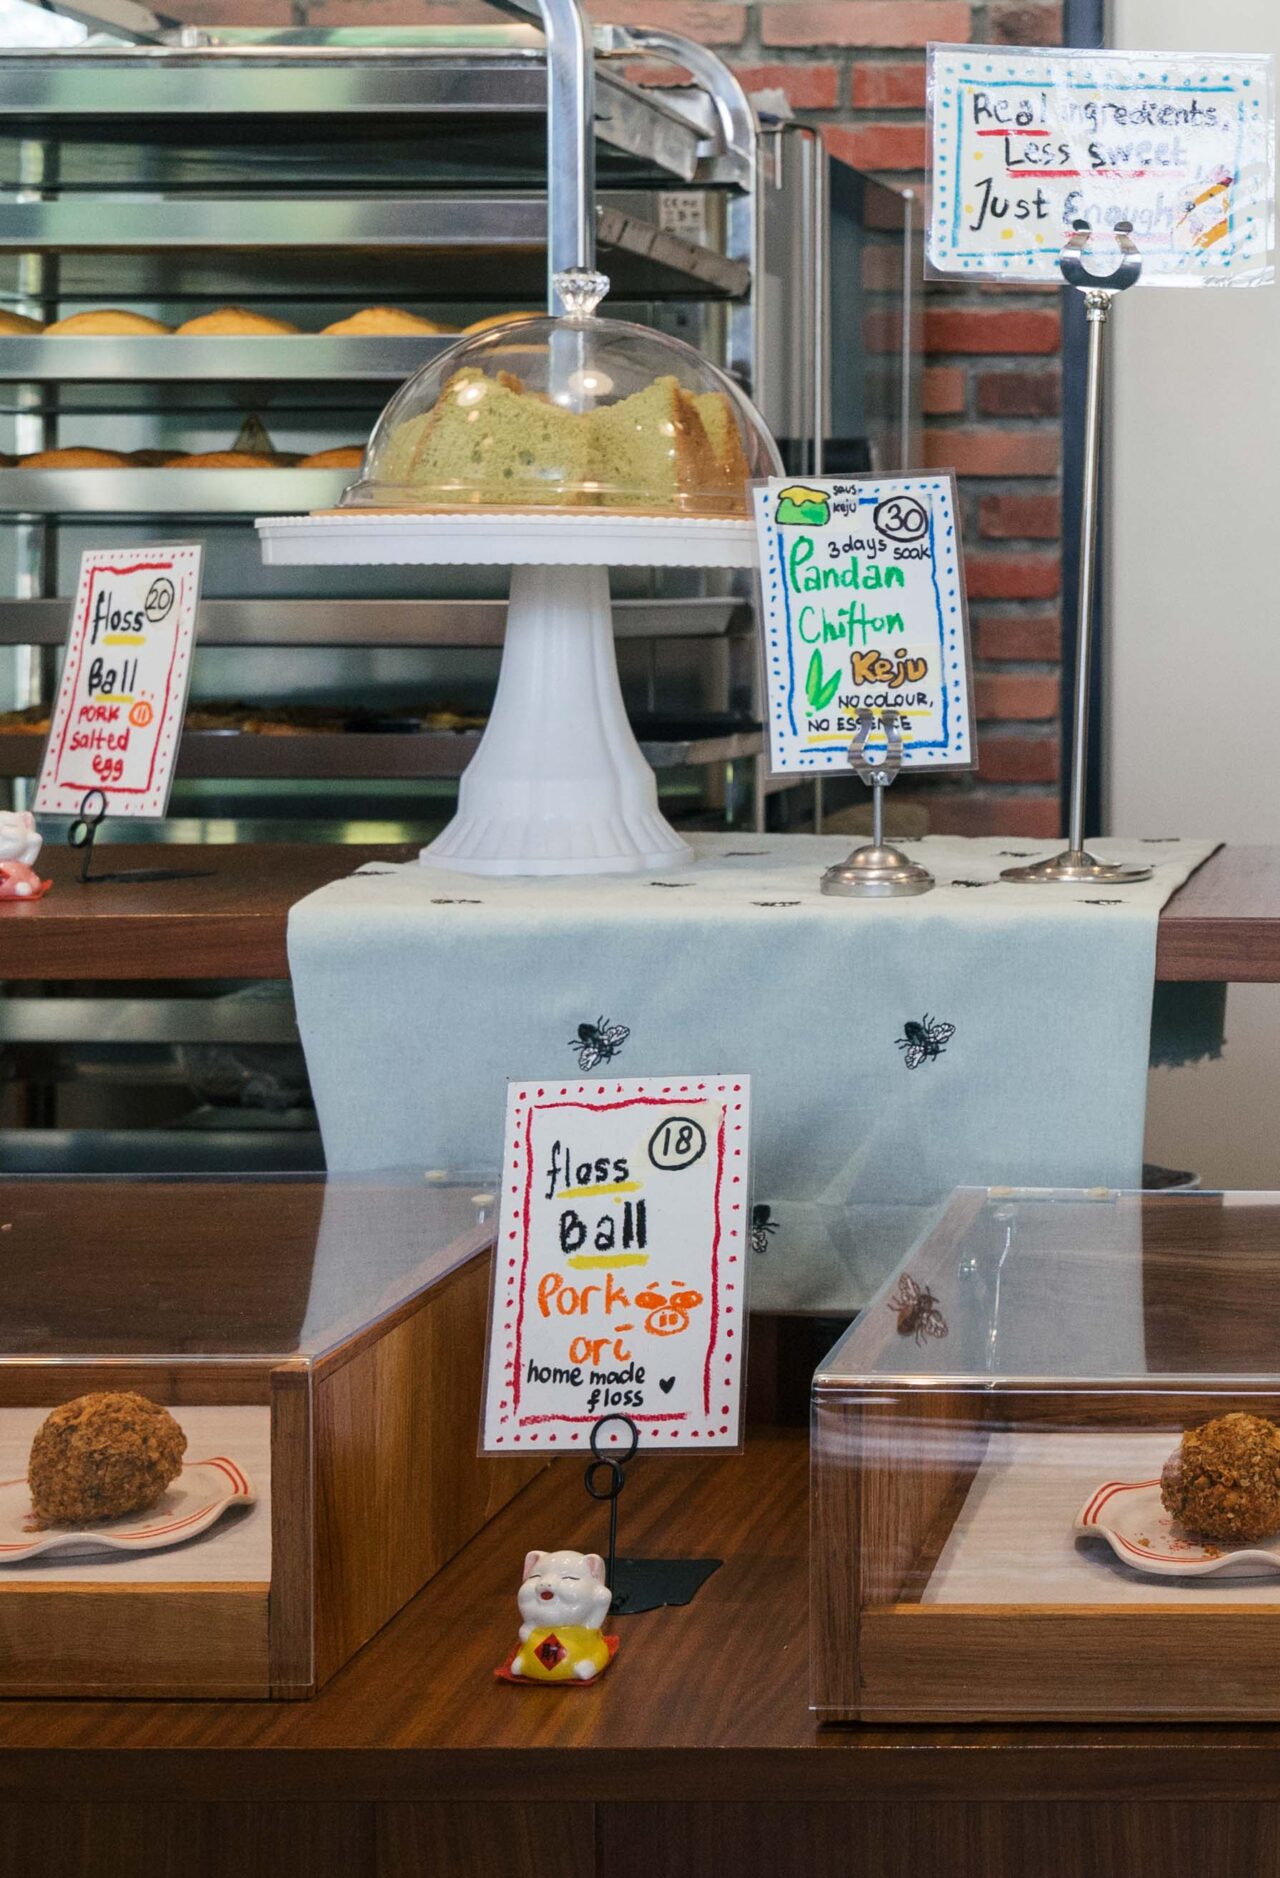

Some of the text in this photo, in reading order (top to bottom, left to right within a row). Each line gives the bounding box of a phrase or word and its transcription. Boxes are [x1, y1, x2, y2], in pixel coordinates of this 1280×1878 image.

[972, 92, 1048, 126] Real
[1004, 136, 1071, 167] Less
[970, 177, 1049, 231] Just
[885, 503, 924, 532] 30
[790, 535, 905, 593] Pandan
[893, 544, 931, 560] soak
[149, 589, 169, 611] 20
[91, 590, 145, 645] floss
[88, 657, 138, 696] Ball
[851, 648, 928, 689] Keju
[838, 692, 934, 709] NO COLOUR,
[808, 719, 830, 731] NO
[92, 754, 124, 782] egg
[663, 1126, 693, 1156] 18
[545, 1140, 629, 1200] floss
[560, 1200, 647, 1254] Ball
[538, 1272, 629, 1318] Pork
[569, 1324, 634, 1365] ori
[527, 1359, 645, 1386] home made
[587, 1388, 644, 1413] floss
